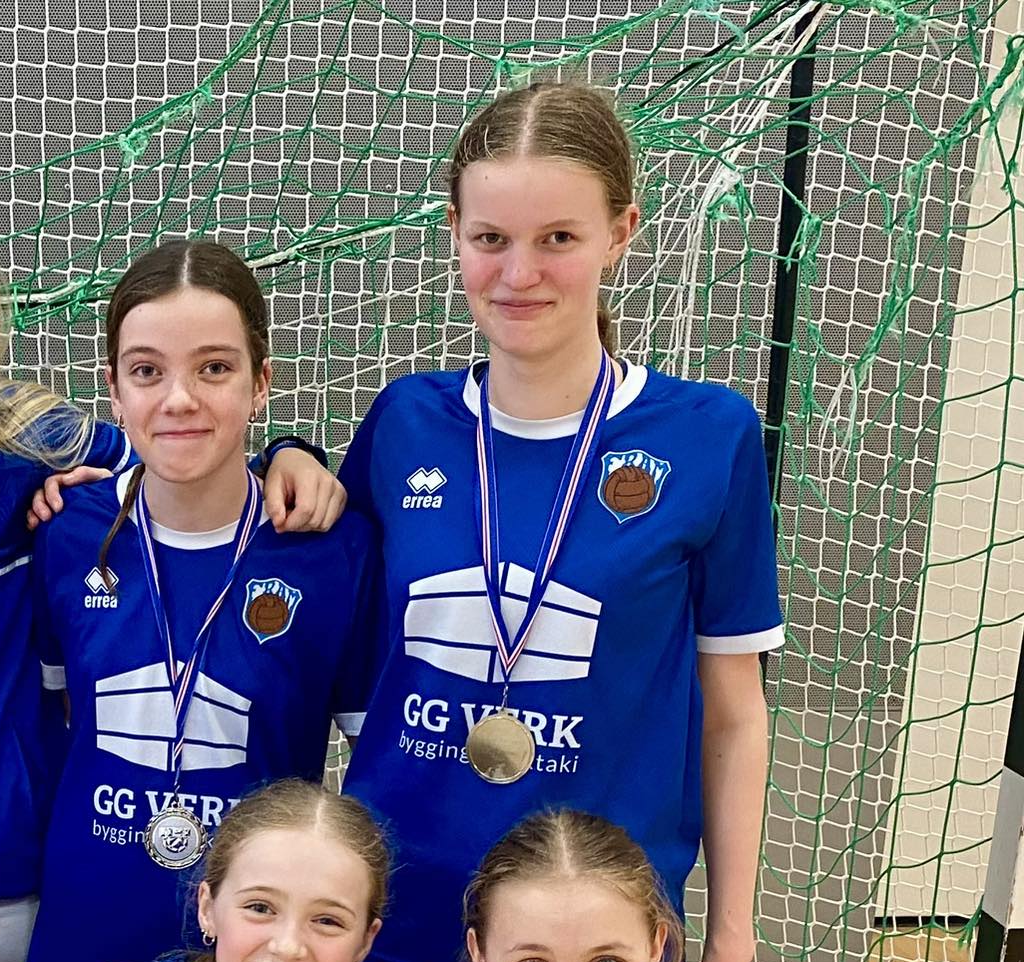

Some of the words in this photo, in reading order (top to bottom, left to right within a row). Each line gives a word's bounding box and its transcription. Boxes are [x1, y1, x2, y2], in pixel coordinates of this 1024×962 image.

[402, 493, 443, 509] errea
[84, 591, 118, 608] errea
[403, 693, 450, 732] GG
[399, 730, 578, 773] byggingtaki
[93, 784, 136, 819] GG
[145, 790, 242, 827] VR
